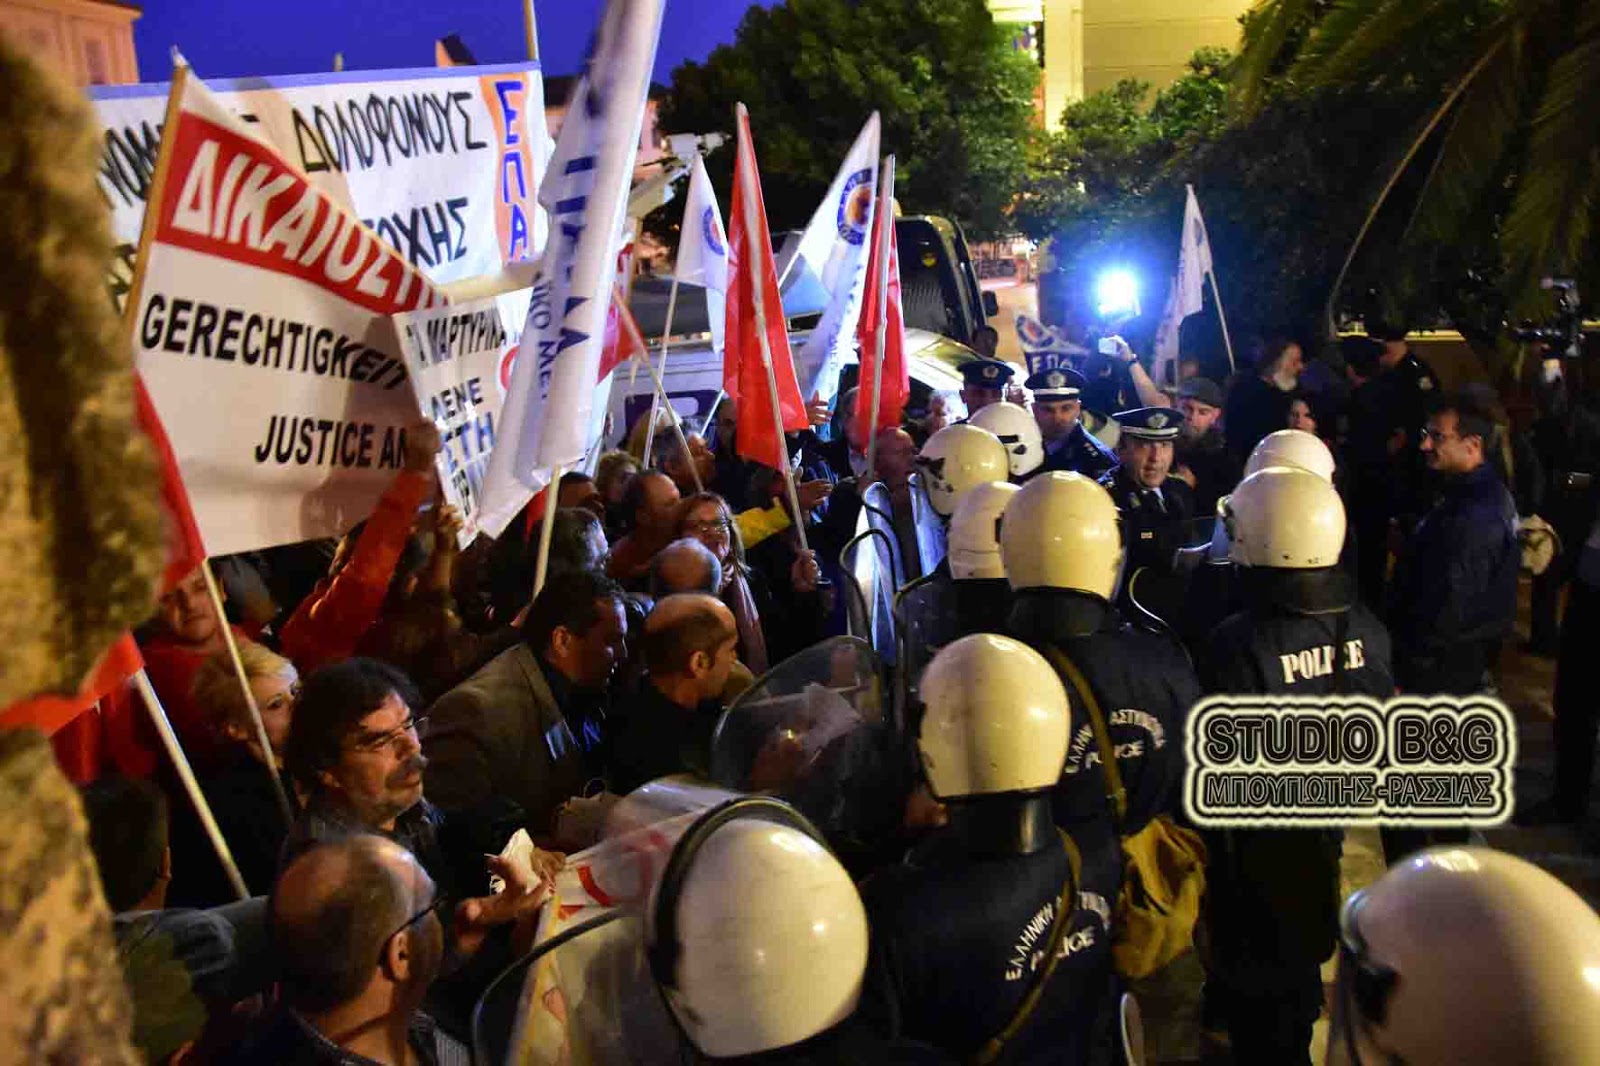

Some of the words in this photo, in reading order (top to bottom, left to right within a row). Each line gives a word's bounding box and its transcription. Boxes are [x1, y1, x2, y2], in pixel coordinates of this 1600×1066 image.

[291, 91, 488, 174] ΔΟΛΟΦΟΝΟΥΣ
[140, 294, 407, 390] GERECHTIGKEIT
[254, 414, 375, 468] JUSTICE
